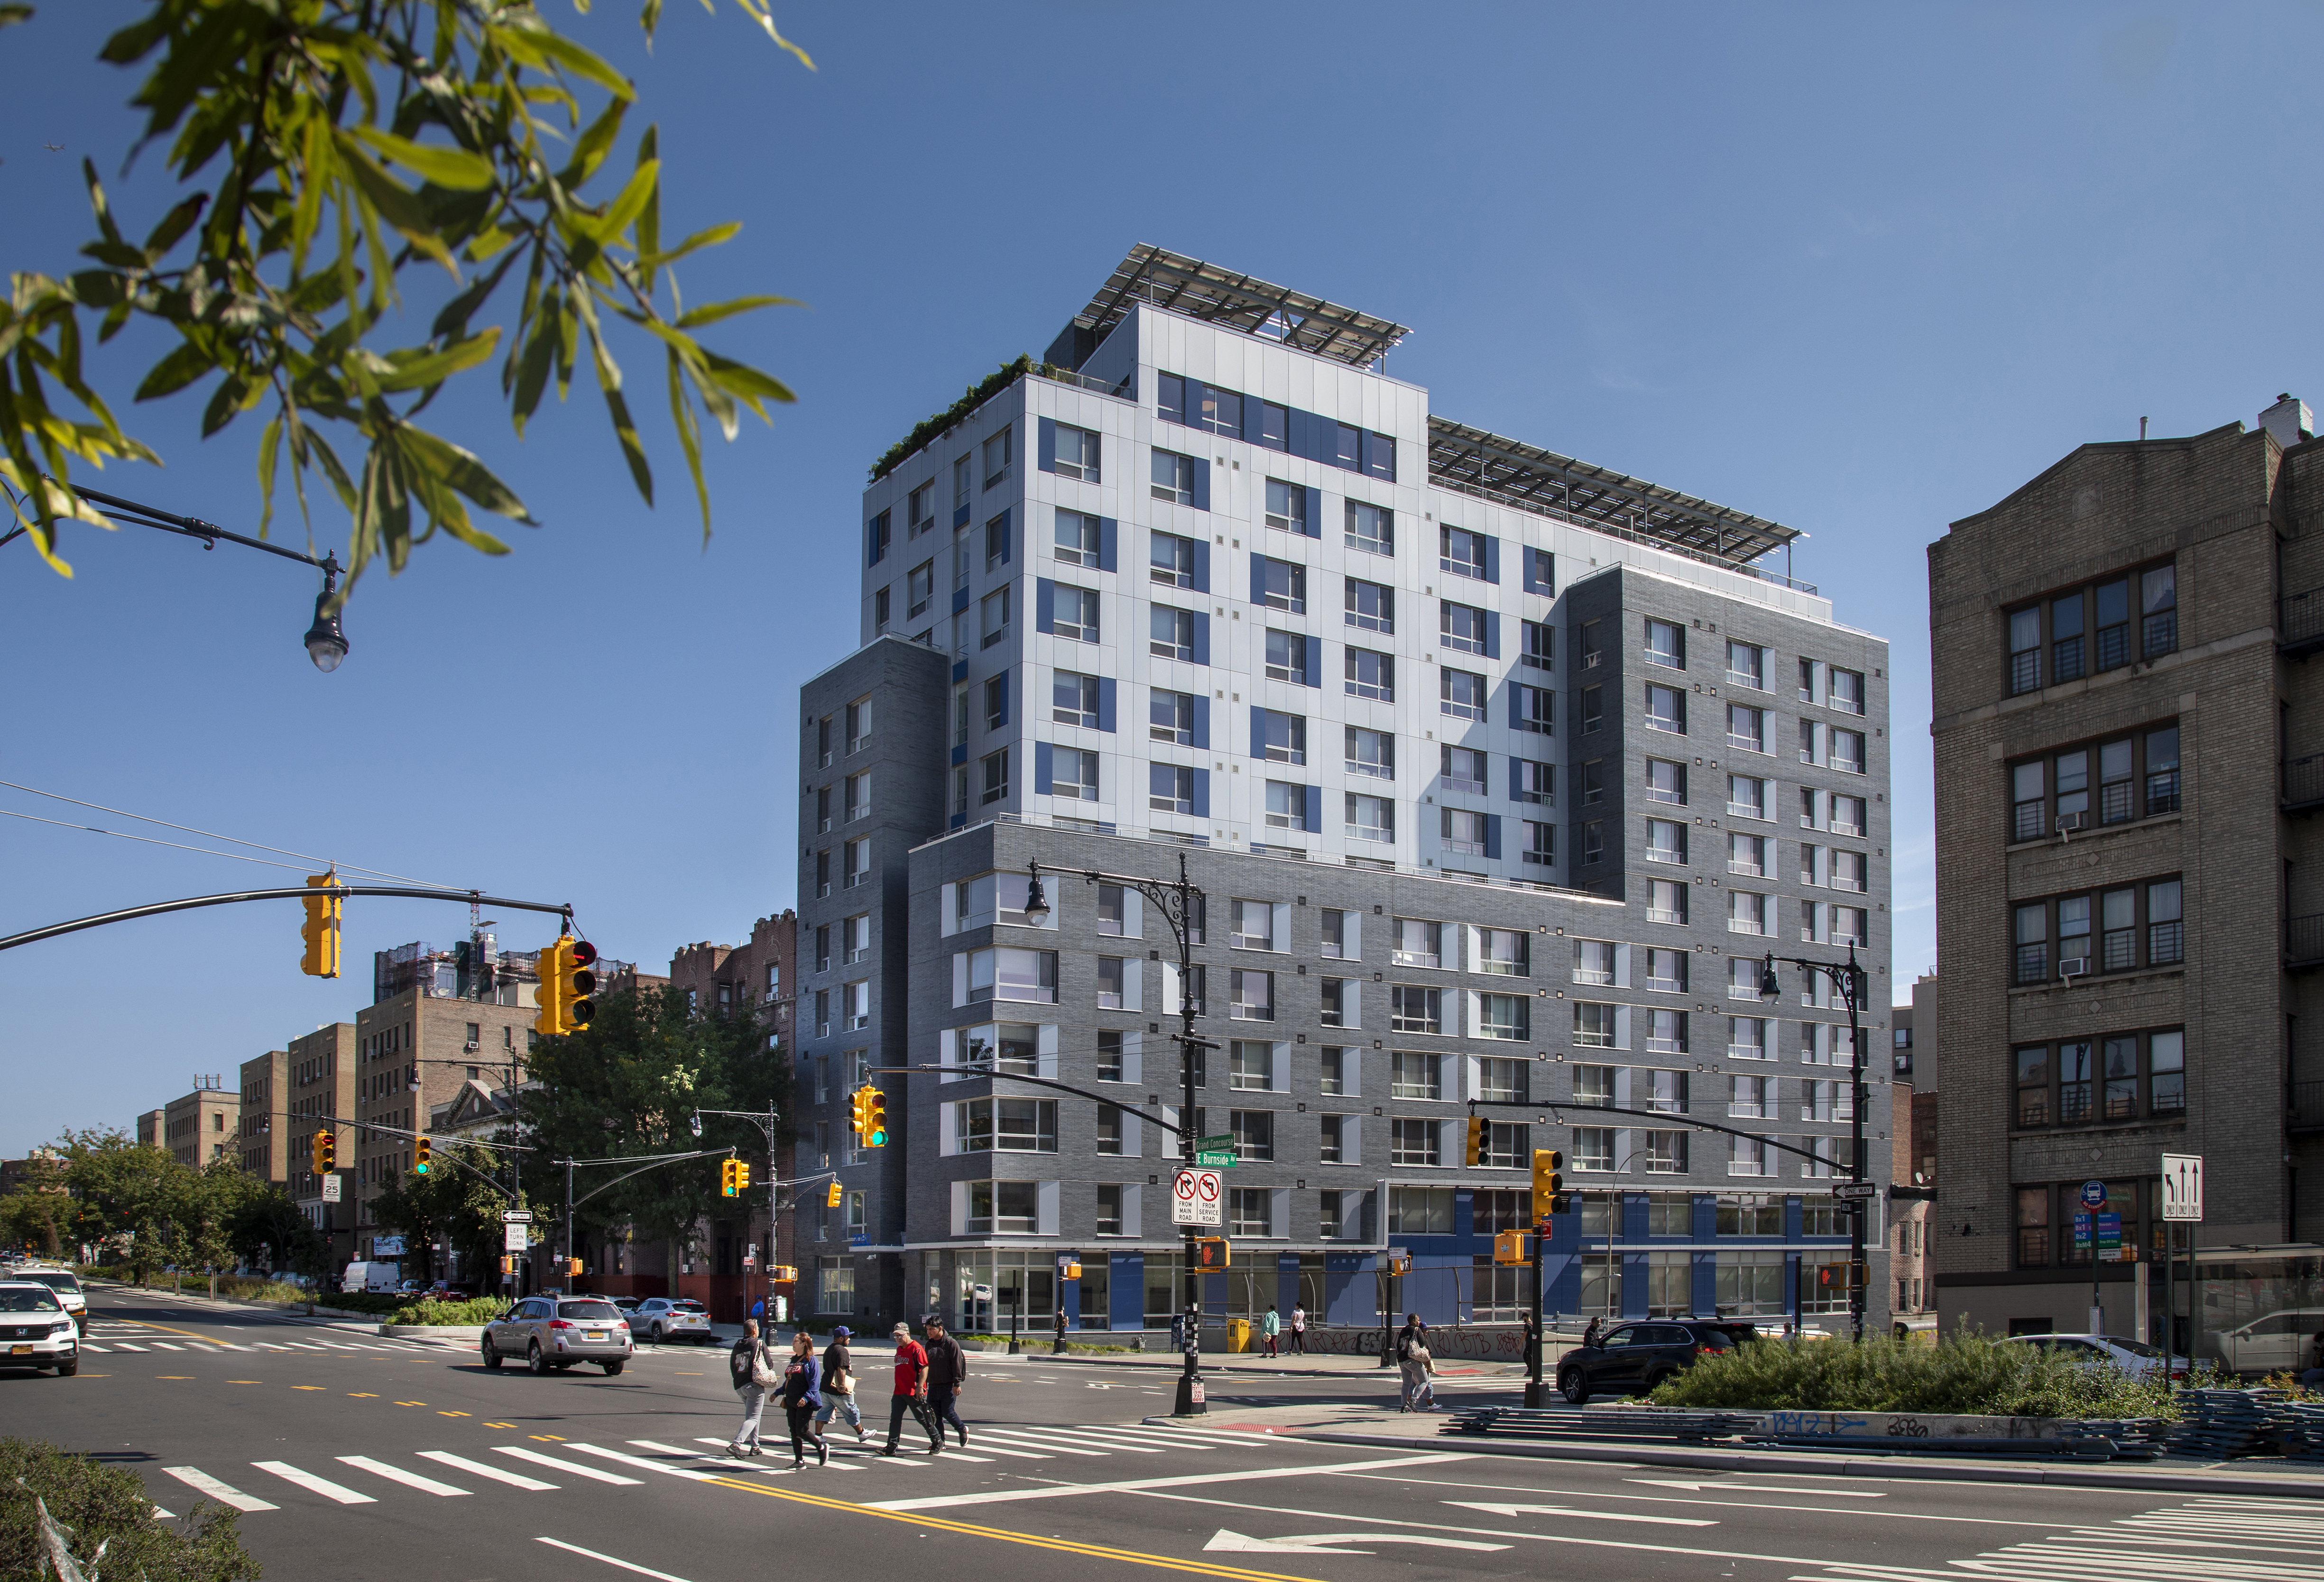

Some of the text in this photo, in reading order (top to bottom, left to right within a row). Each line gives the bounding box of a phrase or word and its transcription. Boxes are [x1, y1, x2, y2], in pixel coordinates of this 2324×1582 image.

[1196, 1139, 1233, 1150] Grand Concourse
[1198, 1153, 1201, 1163] E
[1203, 1153, 1228, 1165] Burnside
[2088, 1200, 2105, 1209] STANDING
[2166, 1205, 2175, 1214] ONLY
[2179, 1205, 2187, 1214] ONLY
[2191, 1205, 2199, 1215] ONLY
[852, 1233, 871, 1246] 2050
